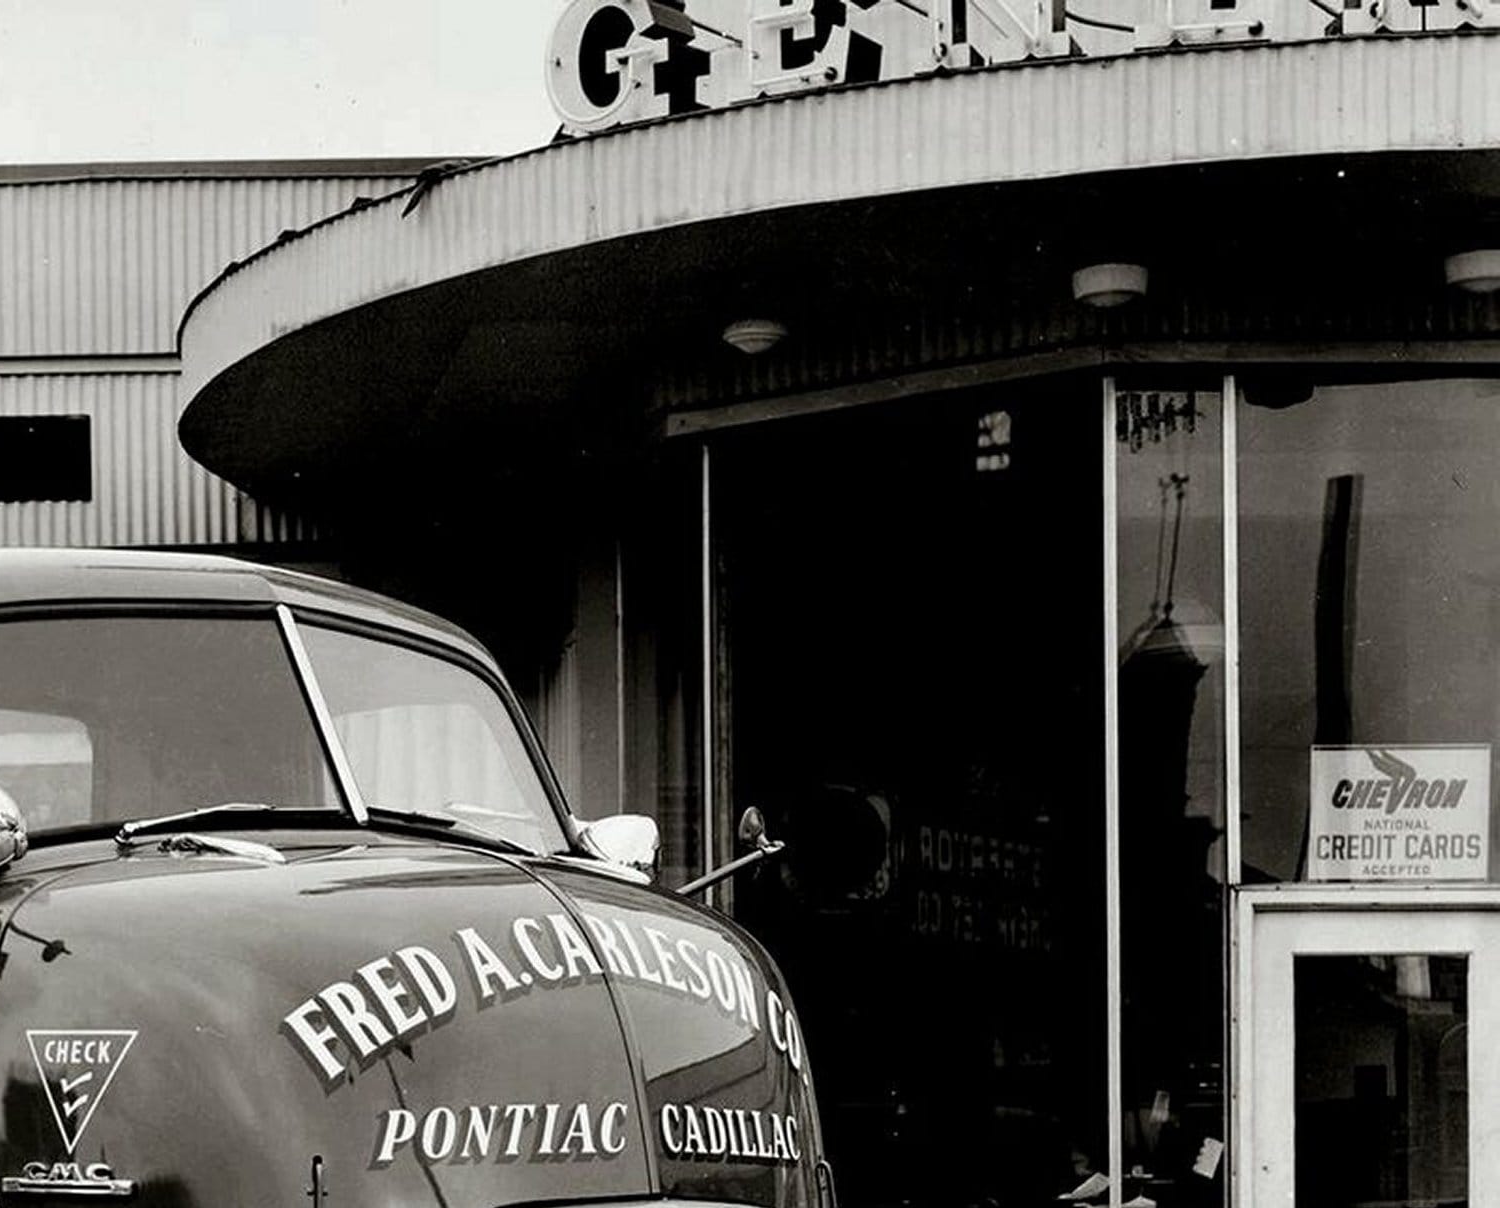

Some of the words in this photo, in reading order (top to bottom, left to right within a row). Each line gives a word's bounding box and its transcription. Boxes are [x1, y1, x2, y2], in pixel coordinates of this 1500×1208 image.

[1331, 778, 1469, 816] CHEVRON
[1363, 819, 1431, 832] NATIONAL
[1316, 834, 1396, 860] CREDIT
[1405, 833, 1482, 860] CARDS
[1362, 864, 1432, 876] ACCEPTED
[283, 944, 458, 1080] FRED
[44, 1040, 113, 1064] CHECK
[376, 1101, 628, 1162] PONTIAC
[661, 1102, 801, 1161] CADILLAC
[22, 1161, 113, 1183] GMC
